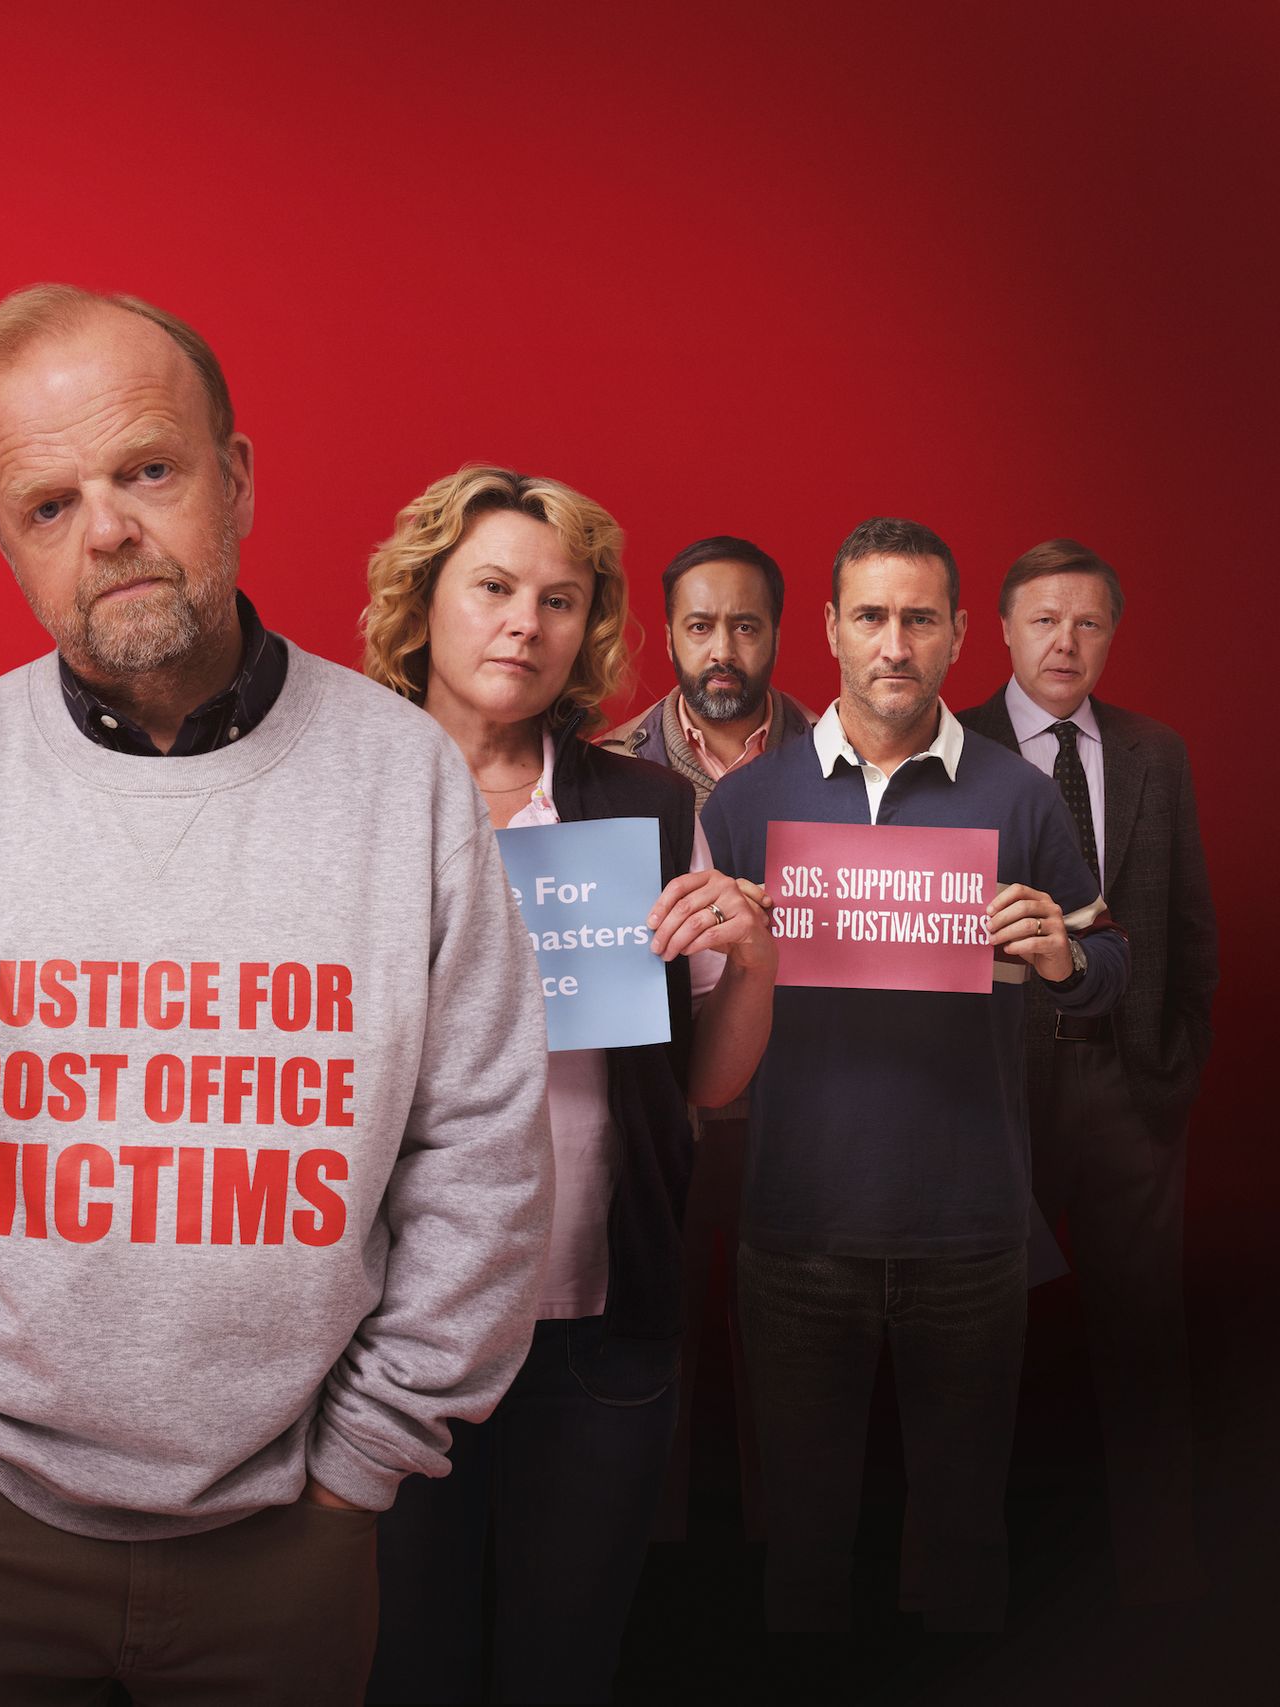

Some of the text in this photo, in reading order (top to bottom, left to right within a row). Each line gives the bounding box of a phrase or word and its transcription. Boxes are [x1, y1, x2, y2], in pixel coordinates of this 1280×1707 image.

[535, 876, 597, 906] For
[781, 866, 984, 904] SOS: SUPPORT OUR
[772, 907, 814, 939] SUB
[837, 910, 991, 945] POSTMASTERS
[238, 962, 354, 1032] FOR
[144, 1053, 355, 1127] OFFICE
